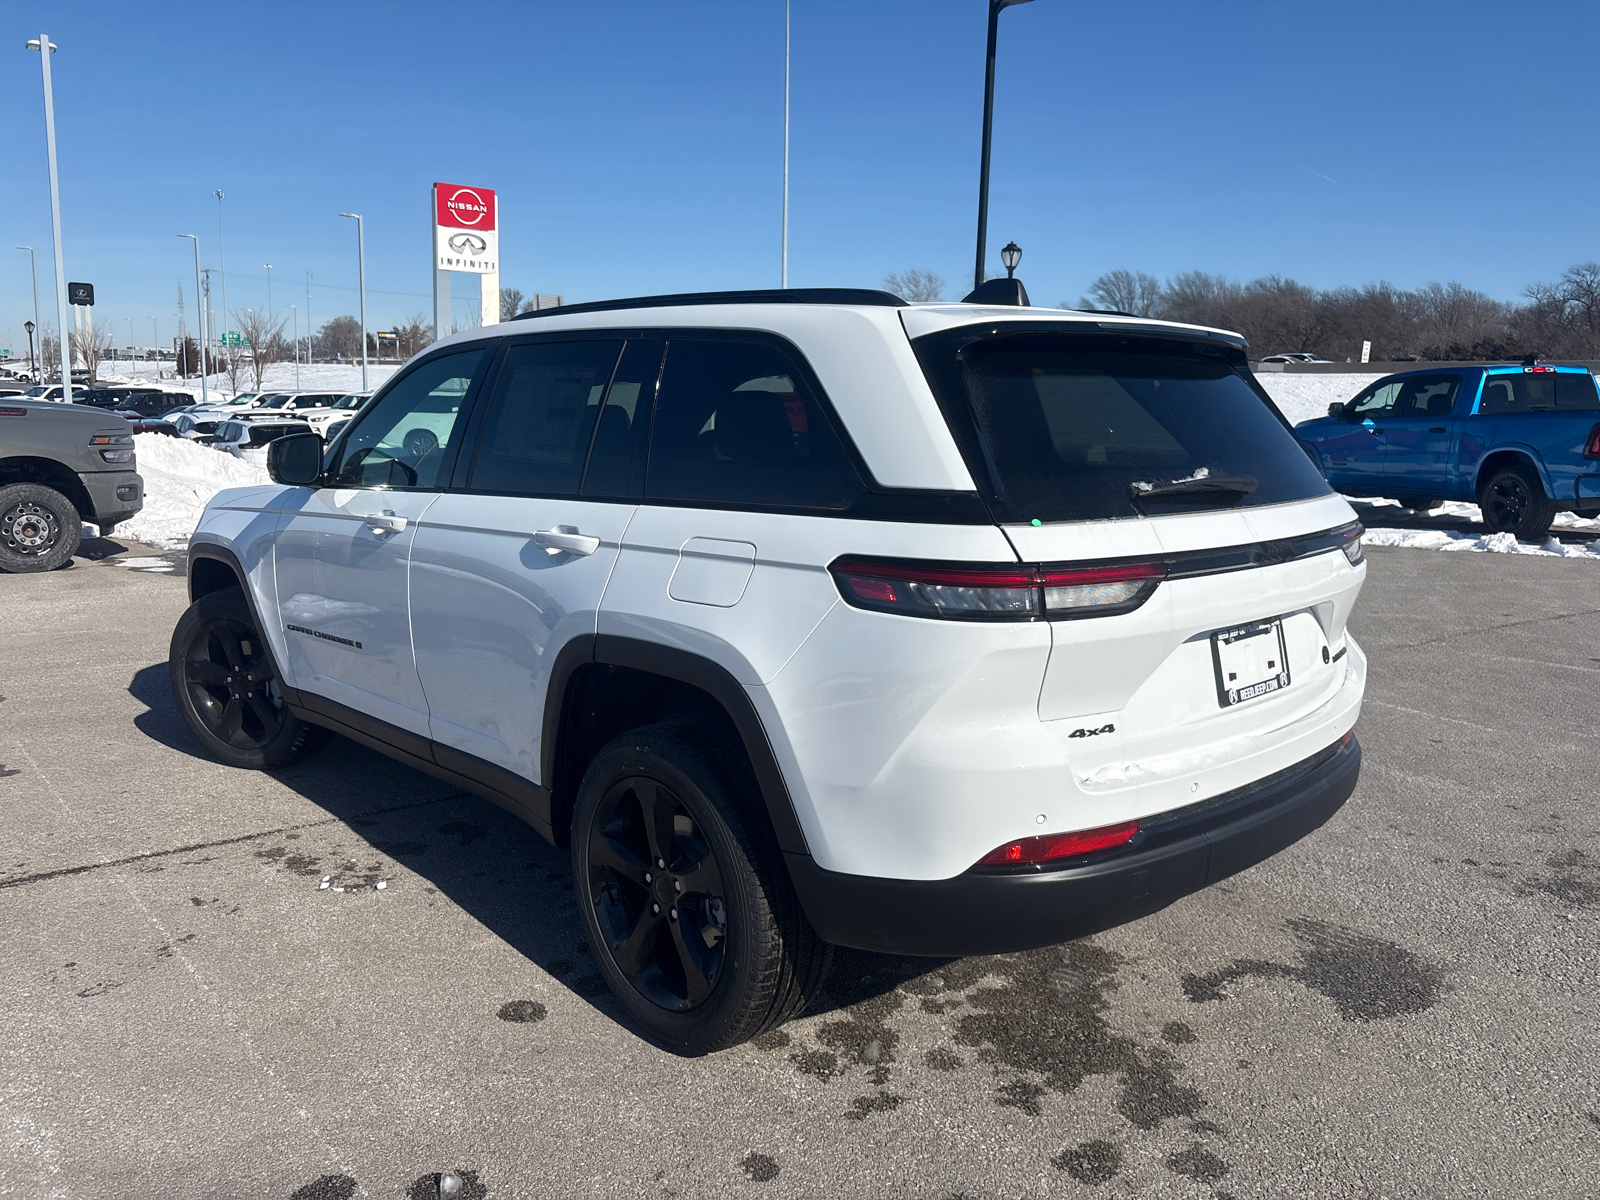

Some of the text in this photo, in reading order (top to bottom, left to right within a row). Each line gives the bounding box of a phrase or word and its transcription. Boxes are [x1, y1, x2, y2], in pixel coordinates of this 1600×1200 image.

[447, 201, 487, 213] NISSAN
[440, 257, 495, 270] INFINITI
[1067, 723, 1116, 738] 4x4
